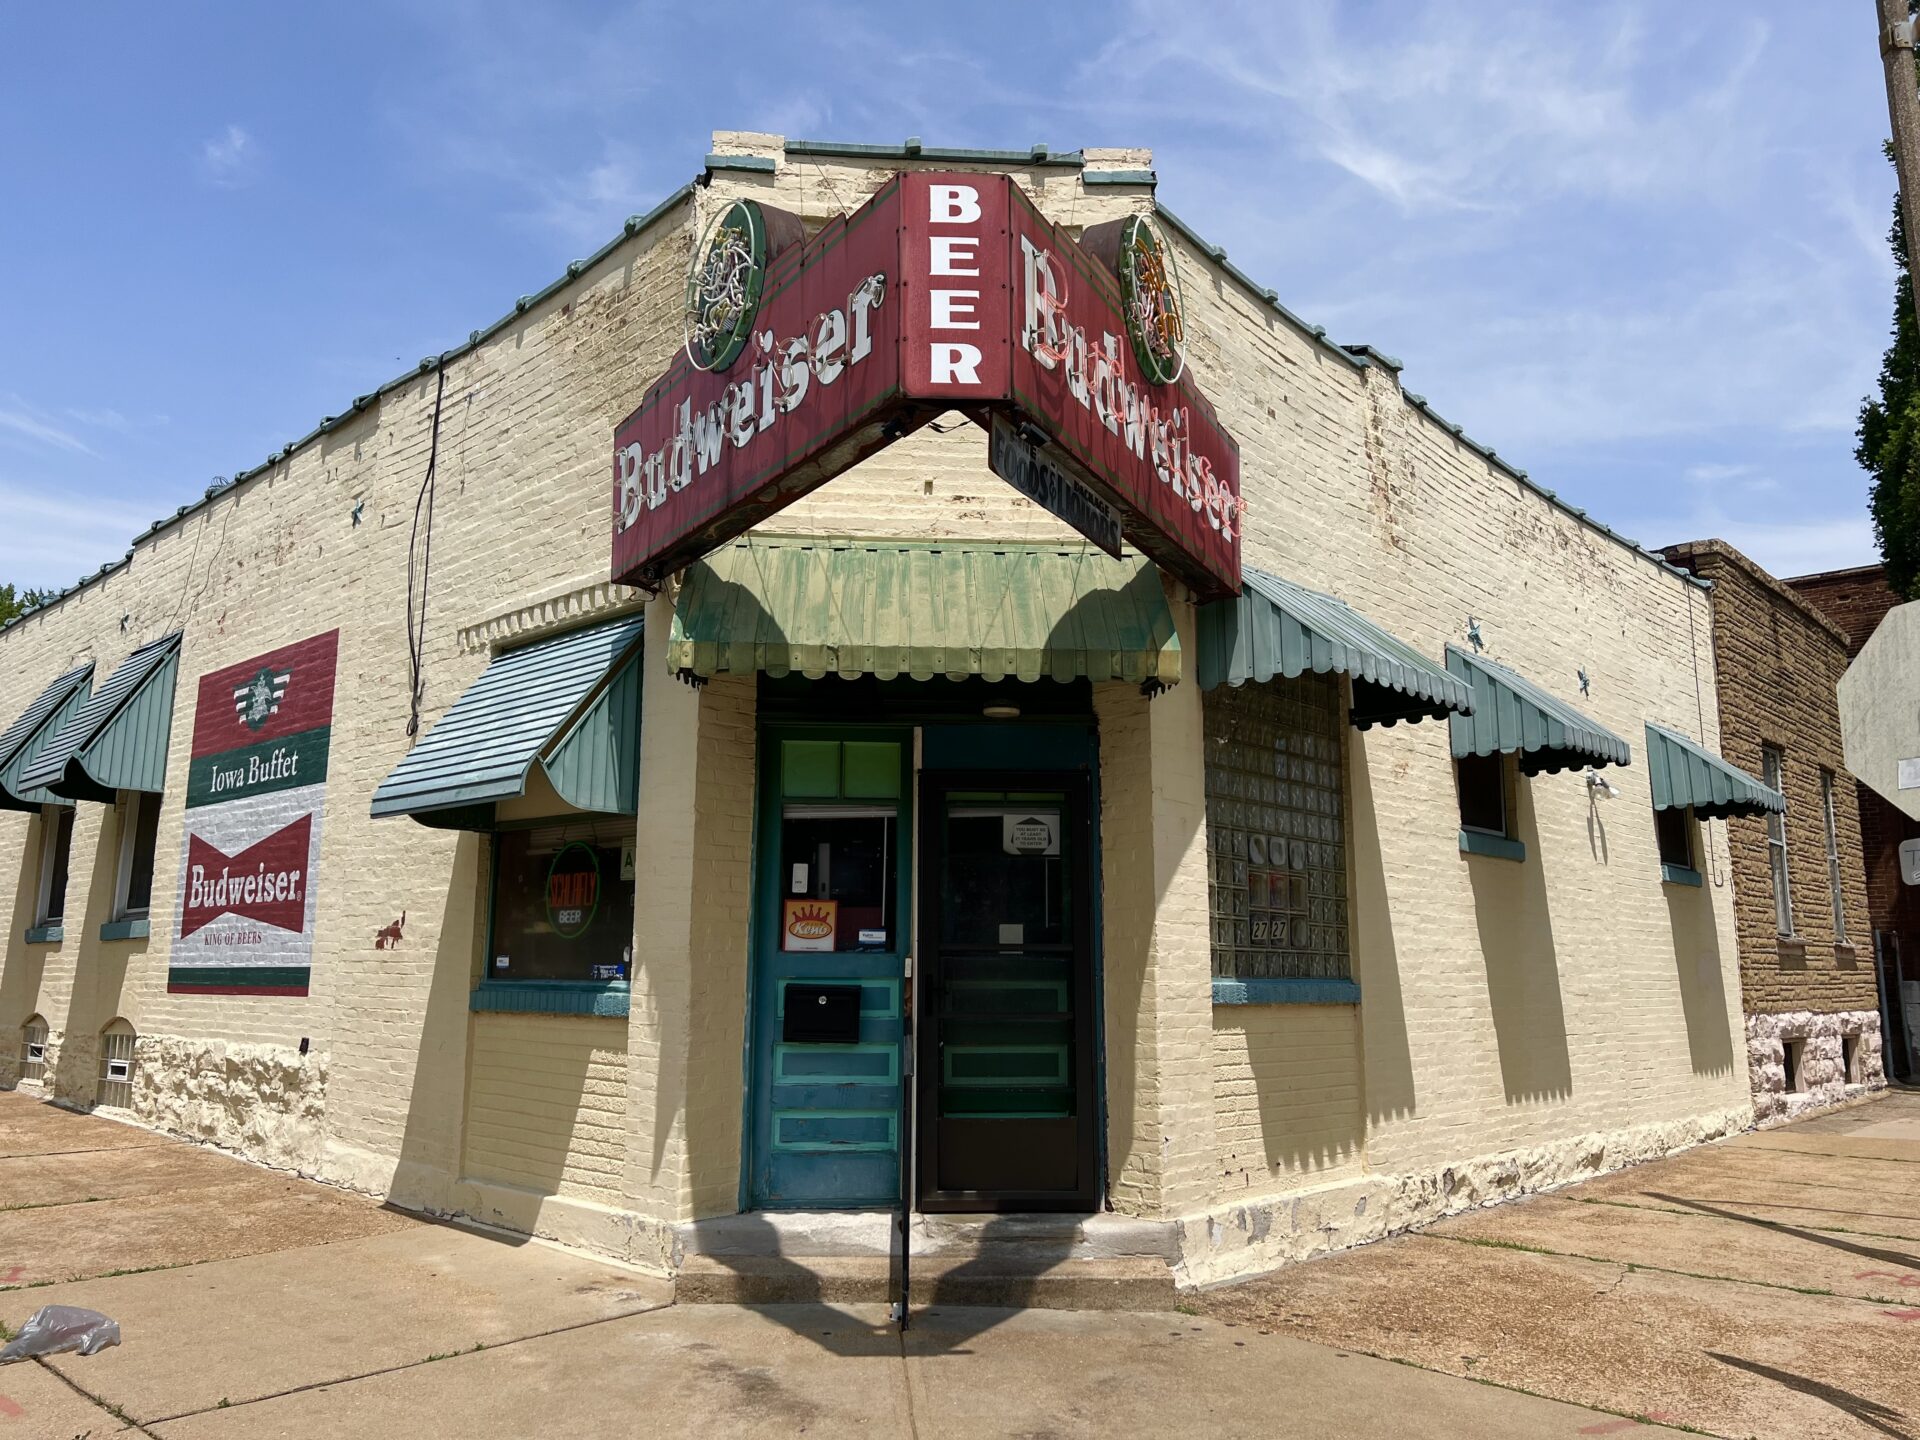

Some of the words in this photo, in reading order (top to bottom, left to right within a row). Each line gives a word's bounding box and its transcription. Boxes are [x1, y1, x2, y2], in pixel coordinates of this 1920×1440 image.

[929, 184, 982, 384] BEER
[615, 272, 887, 535] Budweiser
[1020, 233, 1246, 544] Budweiser
[210, 764, 244, 793] Iowa
[249, 749, 299, 785] Buffet
[624, 852, 633, 867] A
[559, 910, 581, 923] BEER
[1254, 922, 1267, 937] 27
[1273, 921, 1285, 937] 27
[204, 933, 222, 946] KING
[225, 932, 235, 945] OF
[237, 931, 262, 945] BEERS
